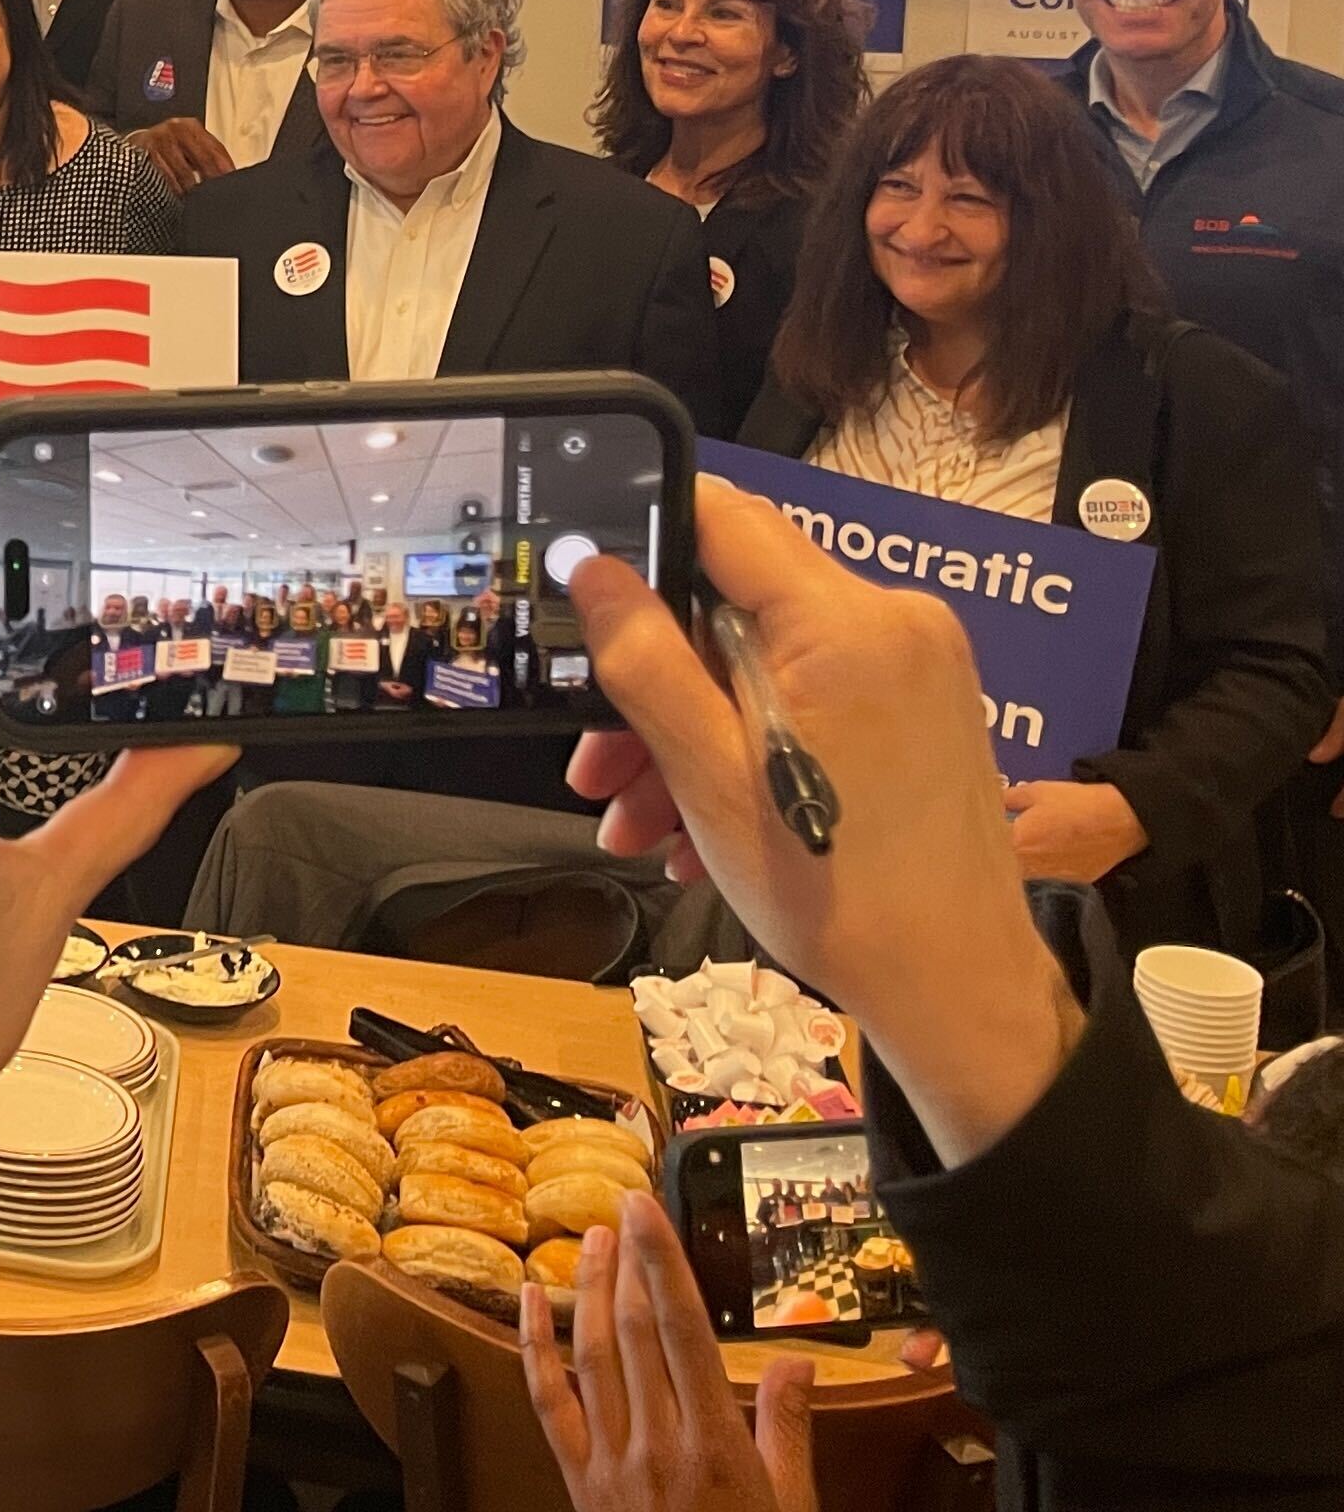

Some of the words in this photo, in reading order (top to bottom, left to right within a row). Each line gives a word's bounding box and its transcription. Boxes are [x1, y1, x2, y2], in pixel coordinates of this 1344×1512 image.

[1007, 29, 1080, 40] AUGUST
[517, 466, 532, 524] PORTRAIT
[1086, 499, 1143, 513] BIDEN
[1088, 513, 1146, 523] HARRIS
[782, 500, 1074, 615] mocratic
[515, 600, 530, 637] VIDEO
